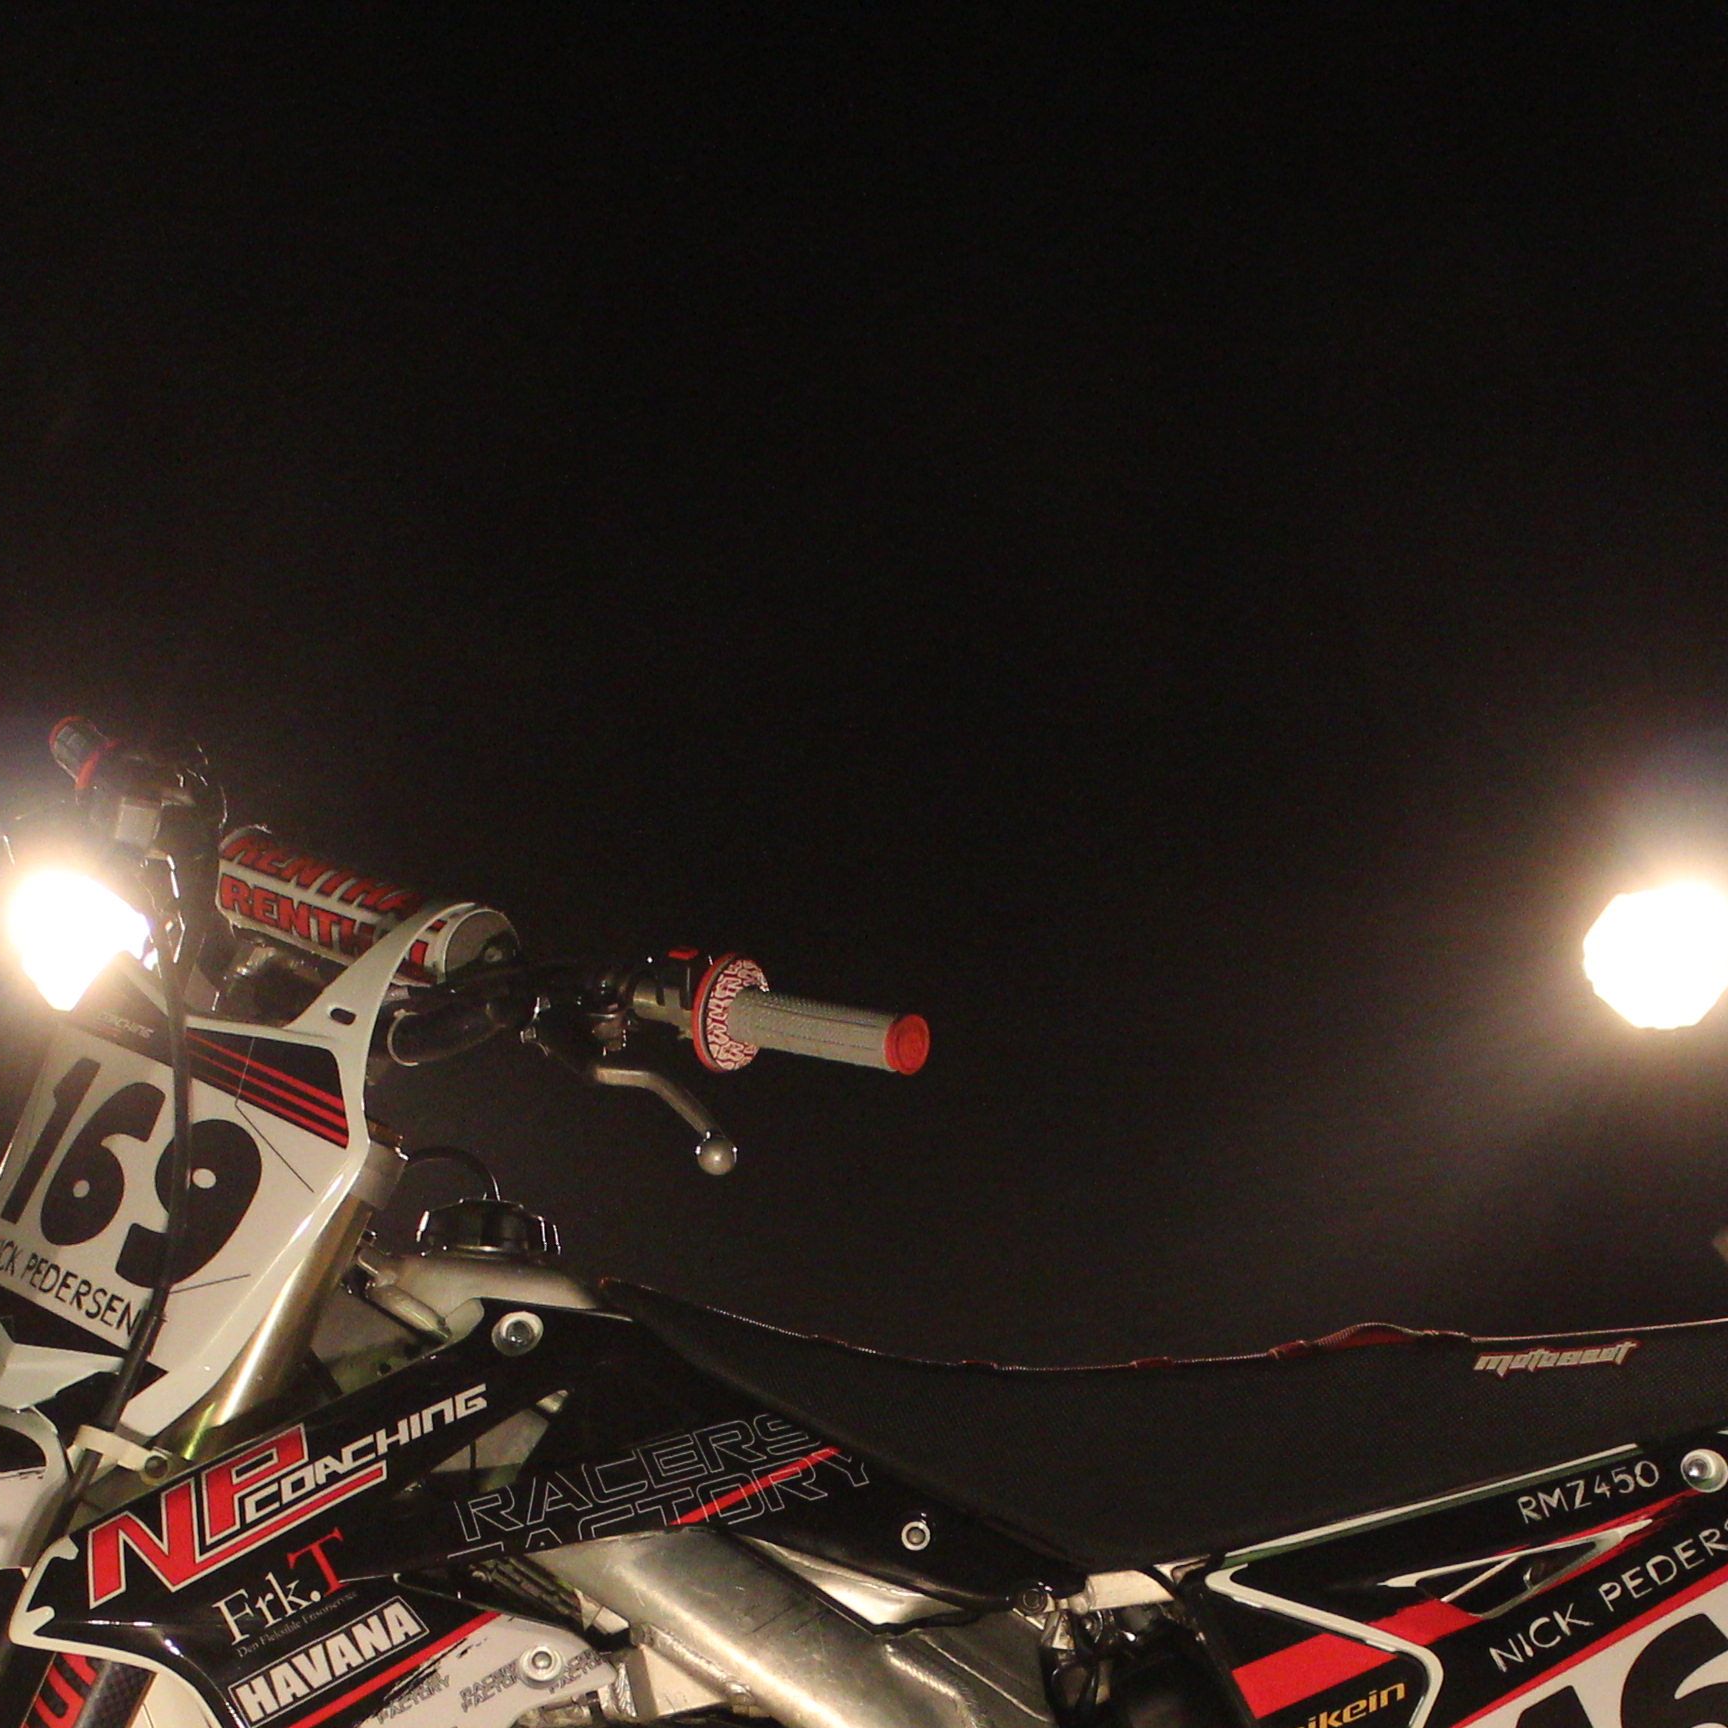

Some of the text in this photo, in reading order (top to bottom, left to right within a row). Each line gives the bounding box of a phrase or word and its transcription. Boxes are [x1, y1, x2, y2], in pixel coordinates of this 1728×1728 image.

[221, 874, 429, 968] RENTH
[0, 1057, 262, 1288] 169
[25, 1252, 145, 1338] PEDERSEN
[89, 1383, 488, 1610] NP COACHING
[447, 1447, 870, 1559] CTORY
[454, 1413, 823, 1541] RACERS
[1517, 1460, 1660, 1524] RMZ450
[235, 1601, 423, 1723] HAVANA
[1489, 1603, 1594, 1673] NICK
